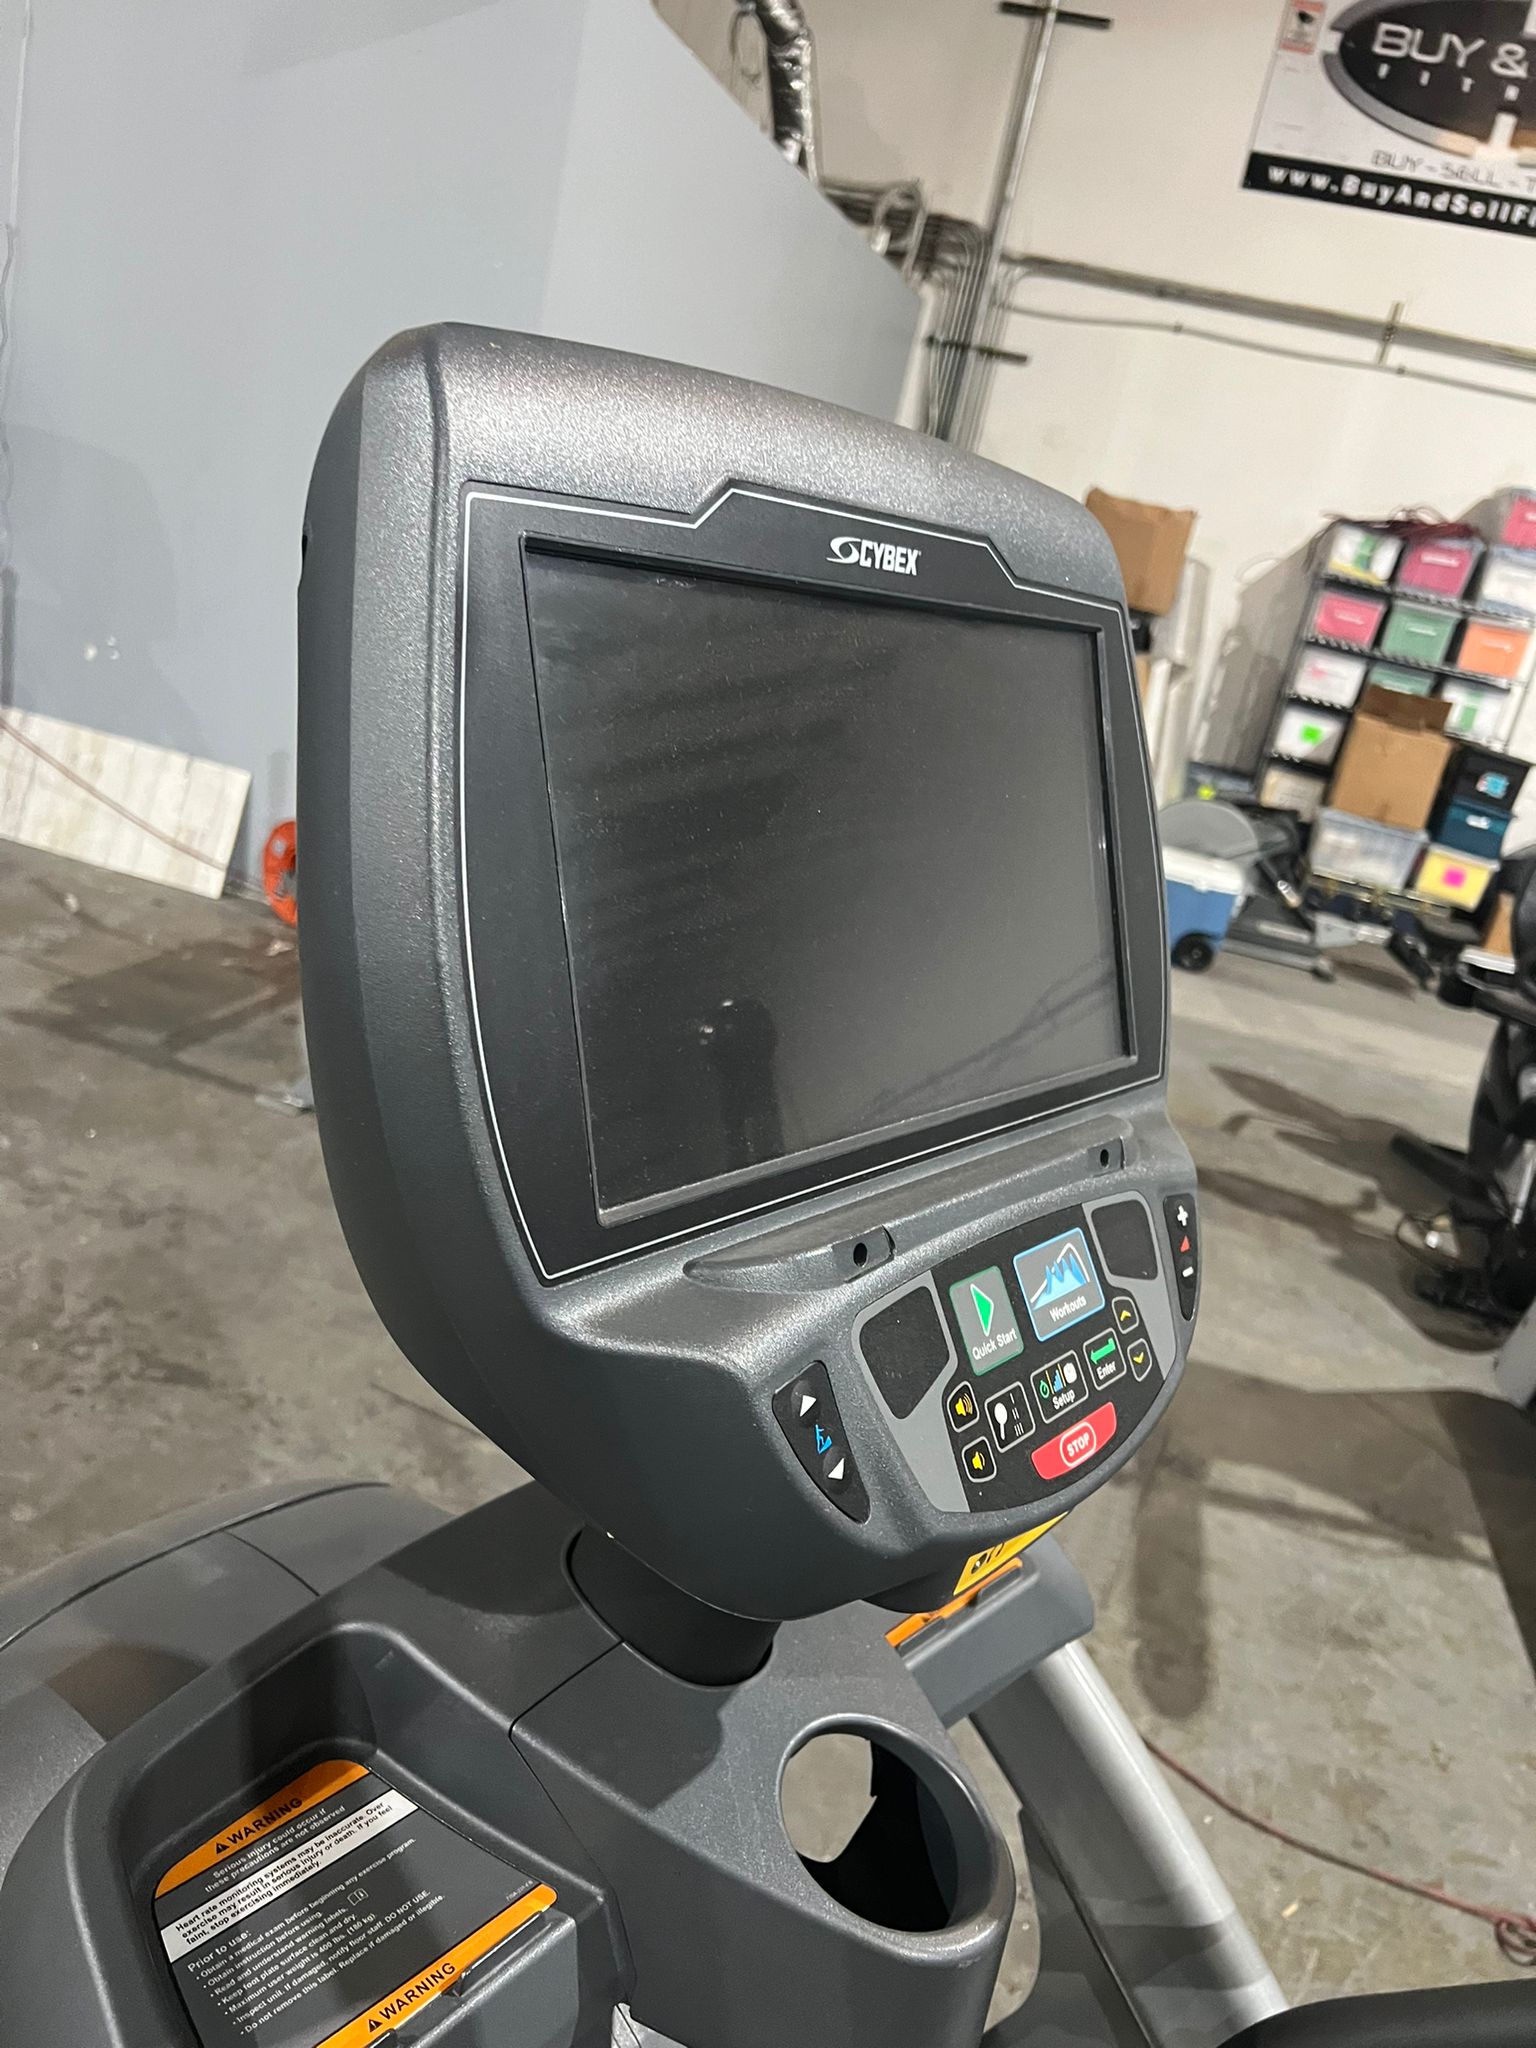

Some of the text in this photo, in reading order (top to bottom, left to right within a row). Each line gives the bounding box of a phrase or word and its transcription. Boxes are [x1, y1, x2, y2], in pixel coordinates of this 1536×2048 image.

[1372, 22, 1529, 79] BUY &
[859, 538, 919, 576] CYBEX
[1050, 1295, 1087, 1321] Workouts
[972, 1327, 1018, 1360] Quick Start
[1096, 1360, 1117, 1379] Enter
[1051, 1390, 1076, 1410] Setup
[1066, 1432, 1091, 1457] STOP
[213, 1856, 246, 1878] Serious
[246, 1841, 271, 1859] injury
[272, 1826, 295, 1843] could
[296, 1813, 318, 1829] occur
[226, 1793, 303, 1845] WARNING
[175, 1914, 200, 1931] Heart
[200, 1904, 217, 1917] rate
[218, 1876, 263, 1906] monitoring
[263, 1856, 297, 1878] systems
[297, 1845, 314, 1859] may
[365, 1802, 383, 1815] Over
[181, 1913, 217, 1938] exercise
[218, 1902, 236, 1916] may
[237, 1886, 261, 1904] result
[271, 1863, 300, 1883] serious
[300, 1848, 323, 1866] injury
[363, 1815, 378, 1827] you
[377, 1804, 392, 1816] feel
[204, 1875, 229, 1892] these
[230, 1845, 279, 1878] precautions
[280, 1837, 293, 1847] are
[294, 1828, 308, 1839] not
[200, 1958, 227, 1978] Obtain
[234, 1934, 264, 1956] medical
[264, 1922, 285, 1937] exam
[284, 1906, 308, 1924] before
[308, 1883, 345, 1909] beginning
[344, 1875, 358, 1886] any
[357, 1856, 386, 1877] exercise
[209, 1916, 229, 1930] stop
[230, 1889, 272, 1917] exercising
[187, 1951, 214, 1972] Prior
[228, 1929, 251, 1947] use:
[207, 1966, 234, 1986] Obtain
[234, 1940, 275, 1969] instruction
[275, 1924, 300, 1942] before
[214, 1978, 235, 1995] Read
[236, 1968, 251, 1981] and
[251, 1940, 294, 1971] understand
[294, 1921, 324, 1943] warning
[221, 1987, 243, 2004] Keep
[242, 1976, 260, 1990] foot
[259, 1963, 279, 1980] plate
[279, 1945, 307, 1965] surface
[307, 1931, 328, 1947] clean
[328, 1921, 342, 1934] and
[228, 1985, 267, 2012] Maximum
[267, 1973, 284, 1987] user
[284, 1956, 311, 1976] weight
[318, 1941, 332, 1953] 400
[236, 2000, 267, 2023] Inspect
[327, 1944, 349, 1961] notify
[348, 1932, 366, 1947] floor
[396, 1900, 412, 1914] NOT
[257, 2011, 272, 2024] not
[272, 1992, 302, 2013] remove
[301, 1981, 318, 1994] this
[338, 1946, 368, 1969] Replace
[374, 1918, 407, 1943] damaged
[379, 1961, 455, 2020] WARNING
